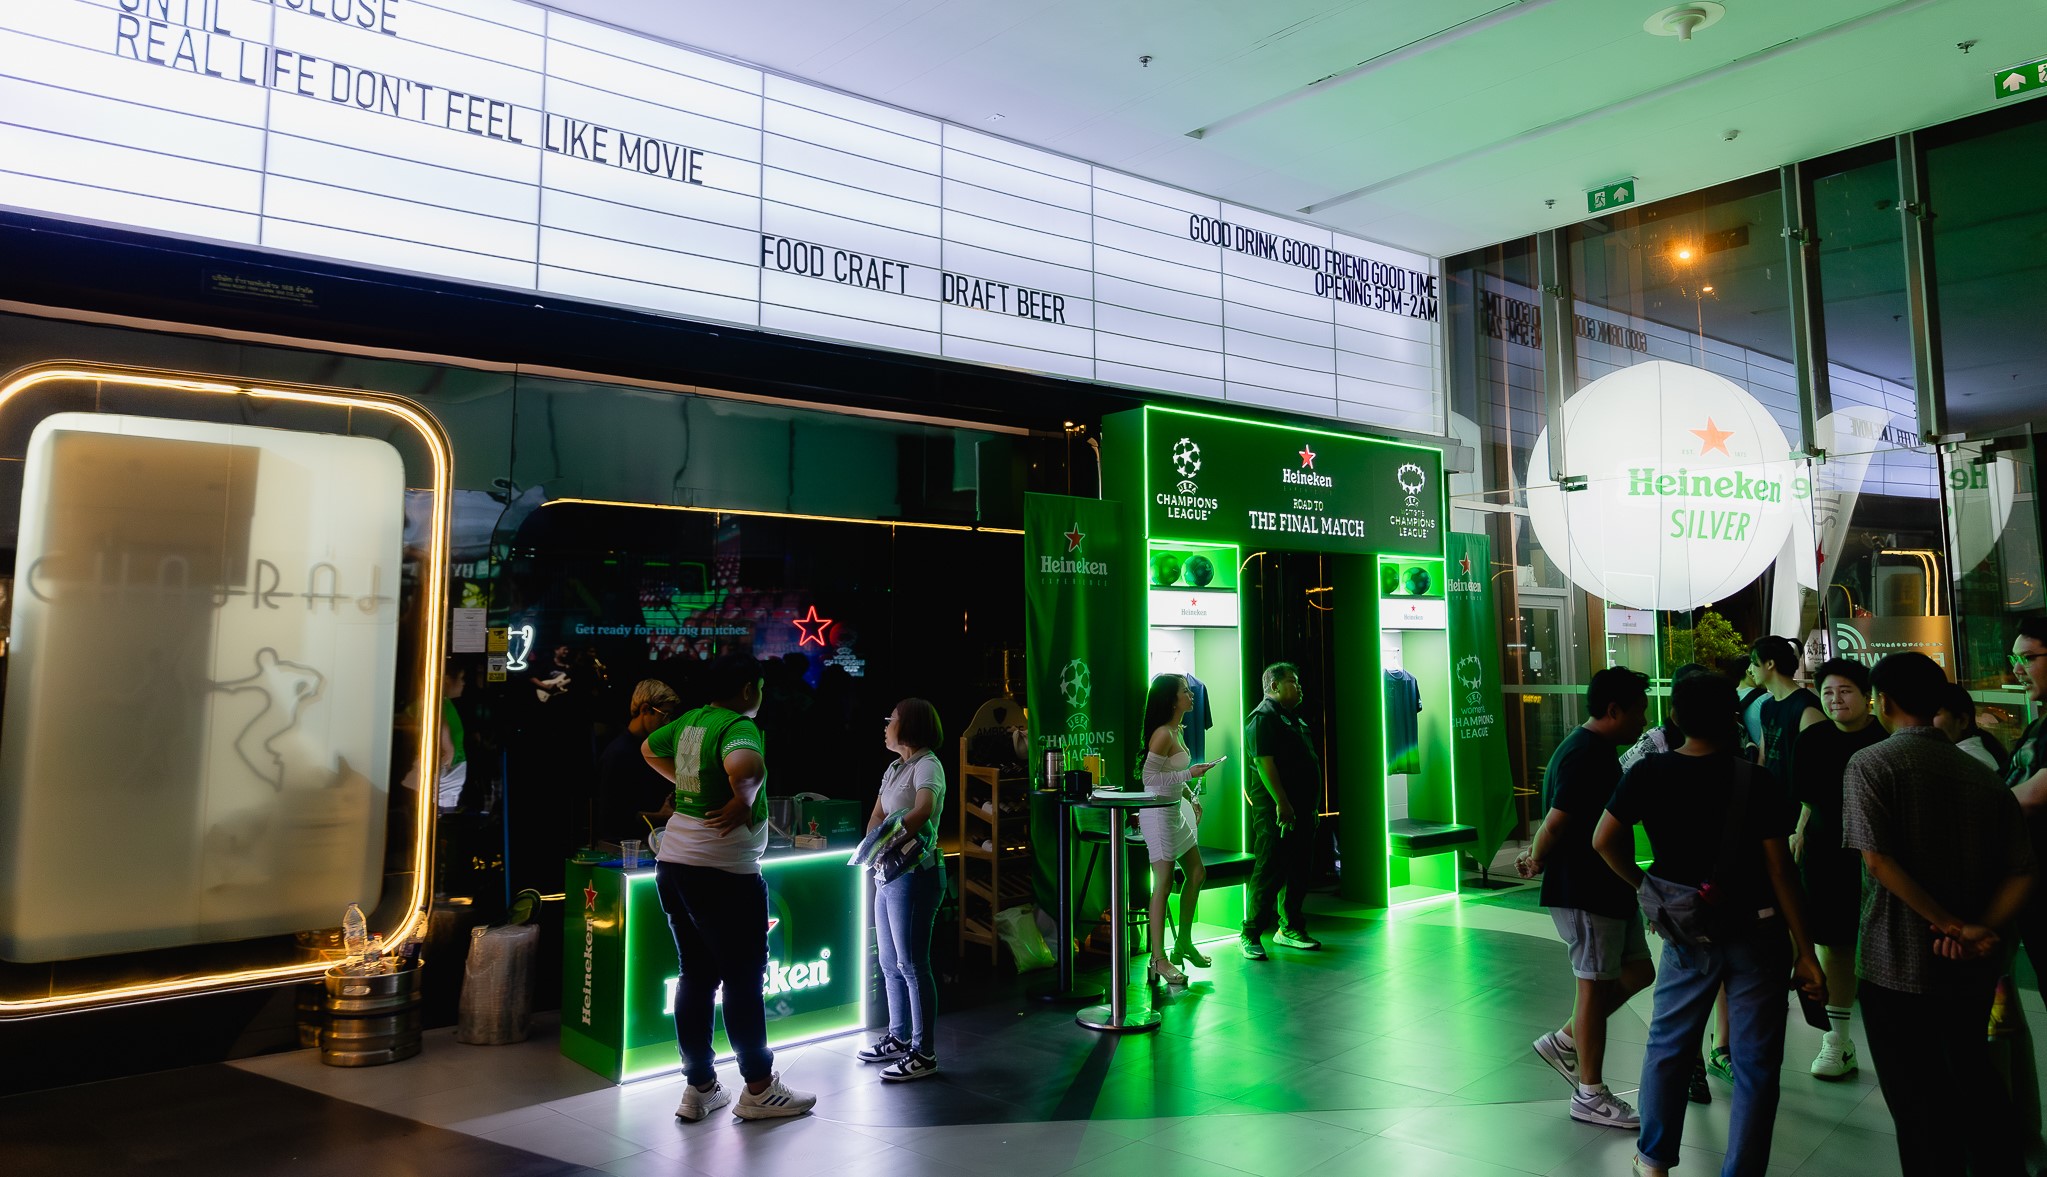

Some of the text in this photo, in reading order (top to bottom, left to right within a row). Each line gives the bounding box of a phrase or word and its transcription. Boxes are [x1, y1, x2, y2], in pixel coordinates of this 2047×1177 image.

[116, 13, 704, 185] REAL LIFE DON'T FEEL LIKE MOVIE
[1190, 215, 1437, 299] GOOD DRINK GOOD FRIEND GOOD TIME
[761, 234, 1066, 324] FOOD CRAFT DRAFT BEER
[1315, 272, 1438, 322] OPENING 5PM-2AM
[1282, 468, 1332, 487] Heineken
[1628, 467, 1781, 503] Heineken
[1156, 493, 1218, 510] CHAMPIONS
[1293, 498, 1324, 511] ROAD TO
[1168, 507, 1208, 521] LEAGUE
[1248, 511, 1365, 537] THE FINAL MATCH
[1390, 515, 1435, 529] CHAMPIONS
[1399, 527, 1427, 539] LEAGUE
[1670, 509, 1751, 541] SILVER
[1040, 555, 1108, 576] Heineken
[1181, 608, 1207, 616] Heineken
[575, 623, 595, 635] Get
[597, 624, 631, 638] ready
[634, 624, 651, 635] for
[656, 624, 676, 636] the
[1067, 715, 1088, 728] UEFA
[582, 915, 595, 1026] Heineken
[663, 957, 831, 1016] Hken
